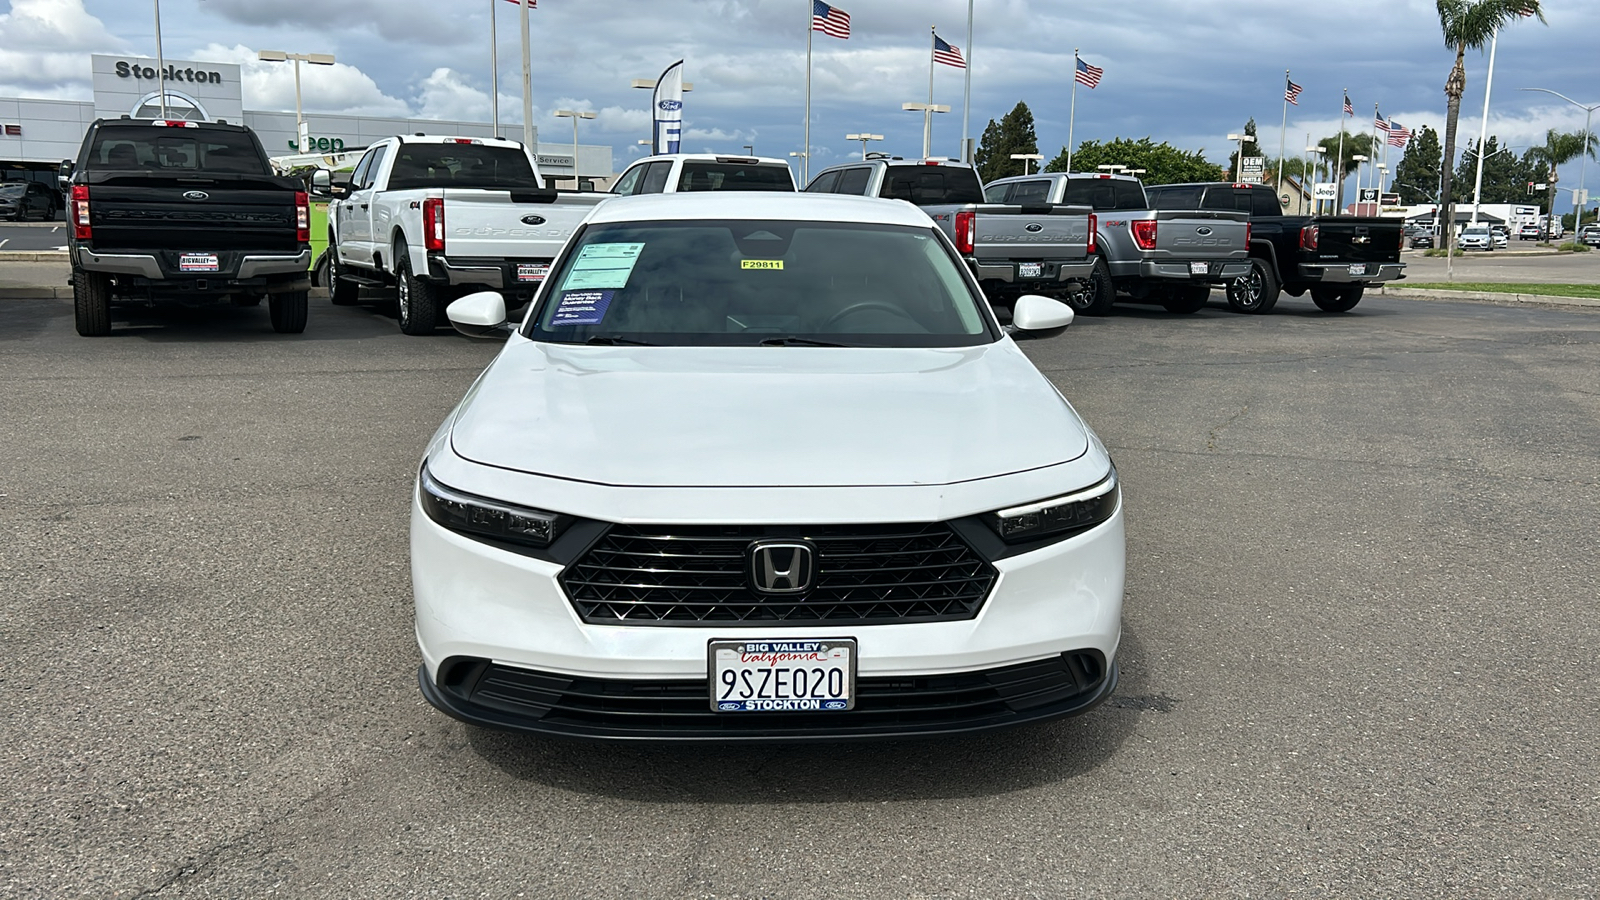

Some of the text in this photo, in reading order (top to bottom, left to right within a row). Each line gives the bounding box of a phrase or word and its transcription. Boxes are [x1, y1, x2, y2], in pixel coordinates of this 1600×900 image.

[115, 61, 221, 84] Stockton
[540, 156, 569, 164] Service
[1243, 158, 1263, 166] OEM
[1316, 188, 1335, 197] Jeep
[455, 228, 540, 237] SUPER
[1042, 234, 1083, 242] DUTY
[743, 261, 780, 269] F29811
[746, 643, 820, 652] BIG VALLEY
[741, 652, 828, 667] California
[720, 667, 844, 700] 9SZE020
[745, 700, 820, 710] STOCKTON
